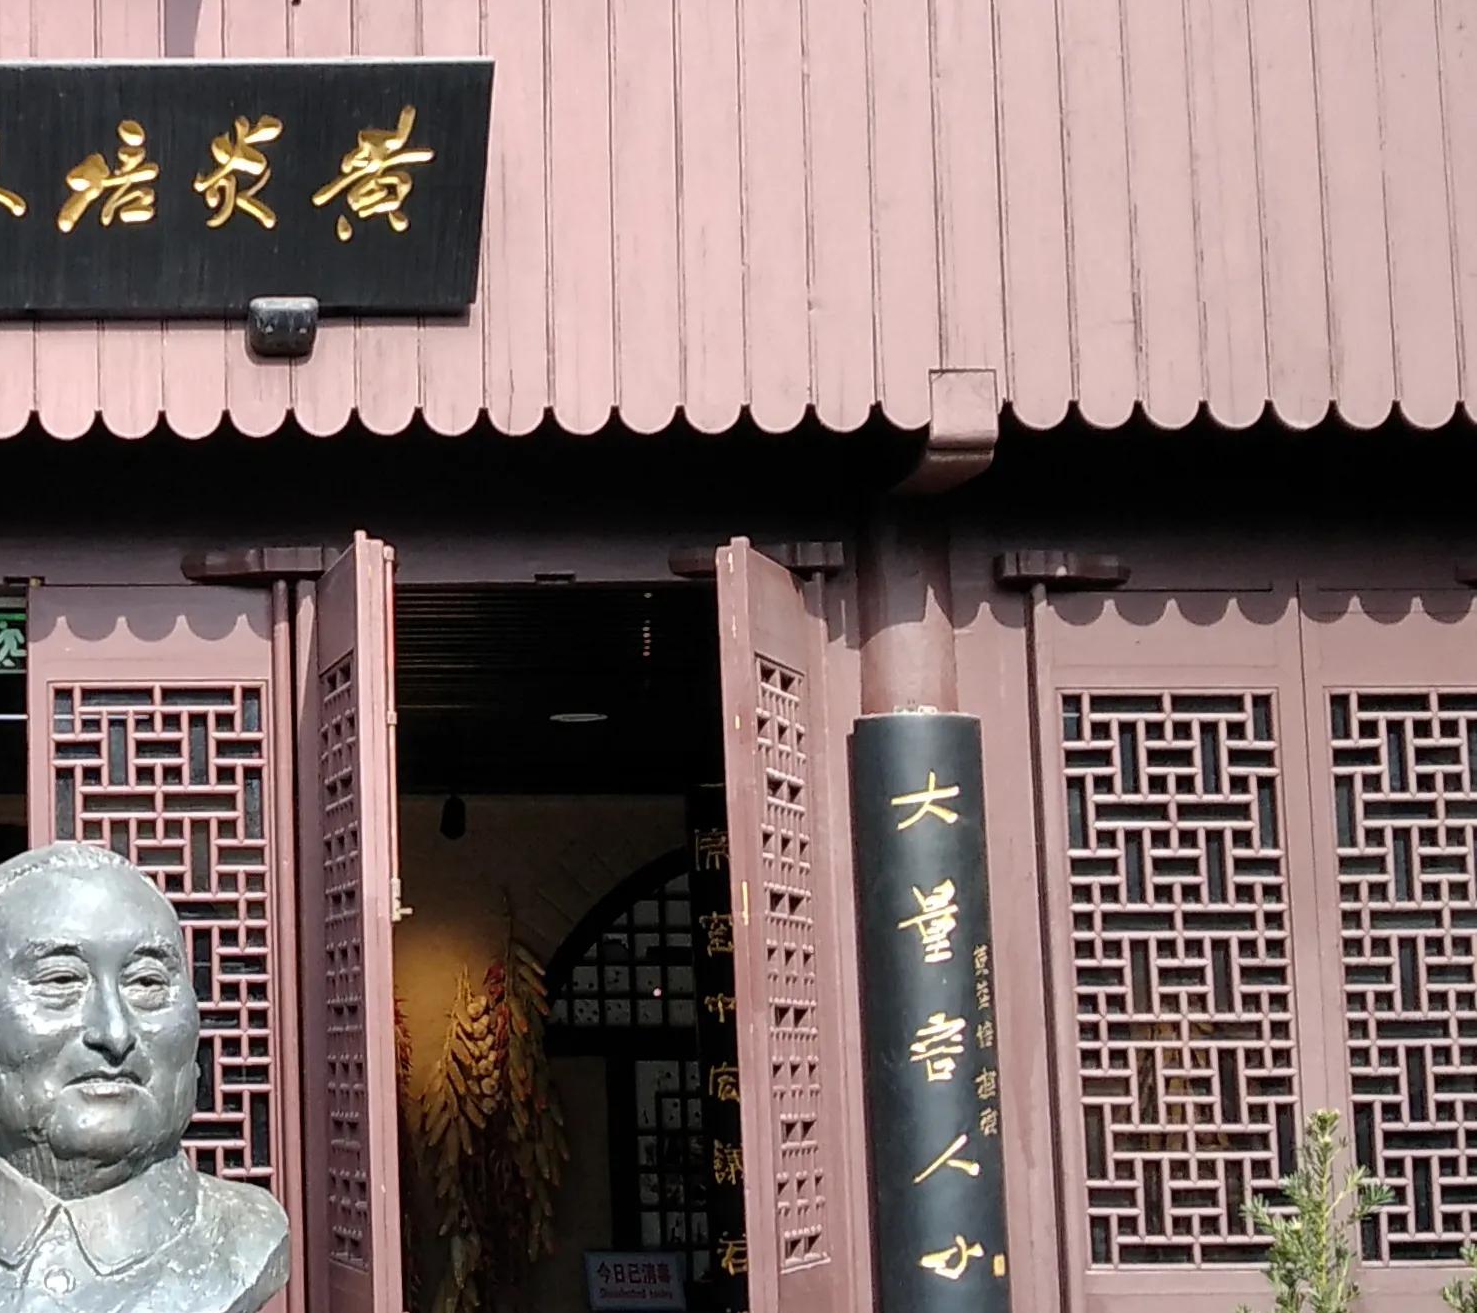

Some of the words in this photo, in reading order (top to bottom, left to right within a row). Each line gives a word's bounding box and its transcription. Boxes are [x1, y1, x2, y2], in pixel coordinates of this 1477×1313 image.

[597, 1261, 671, 1284] 今日已消毒
